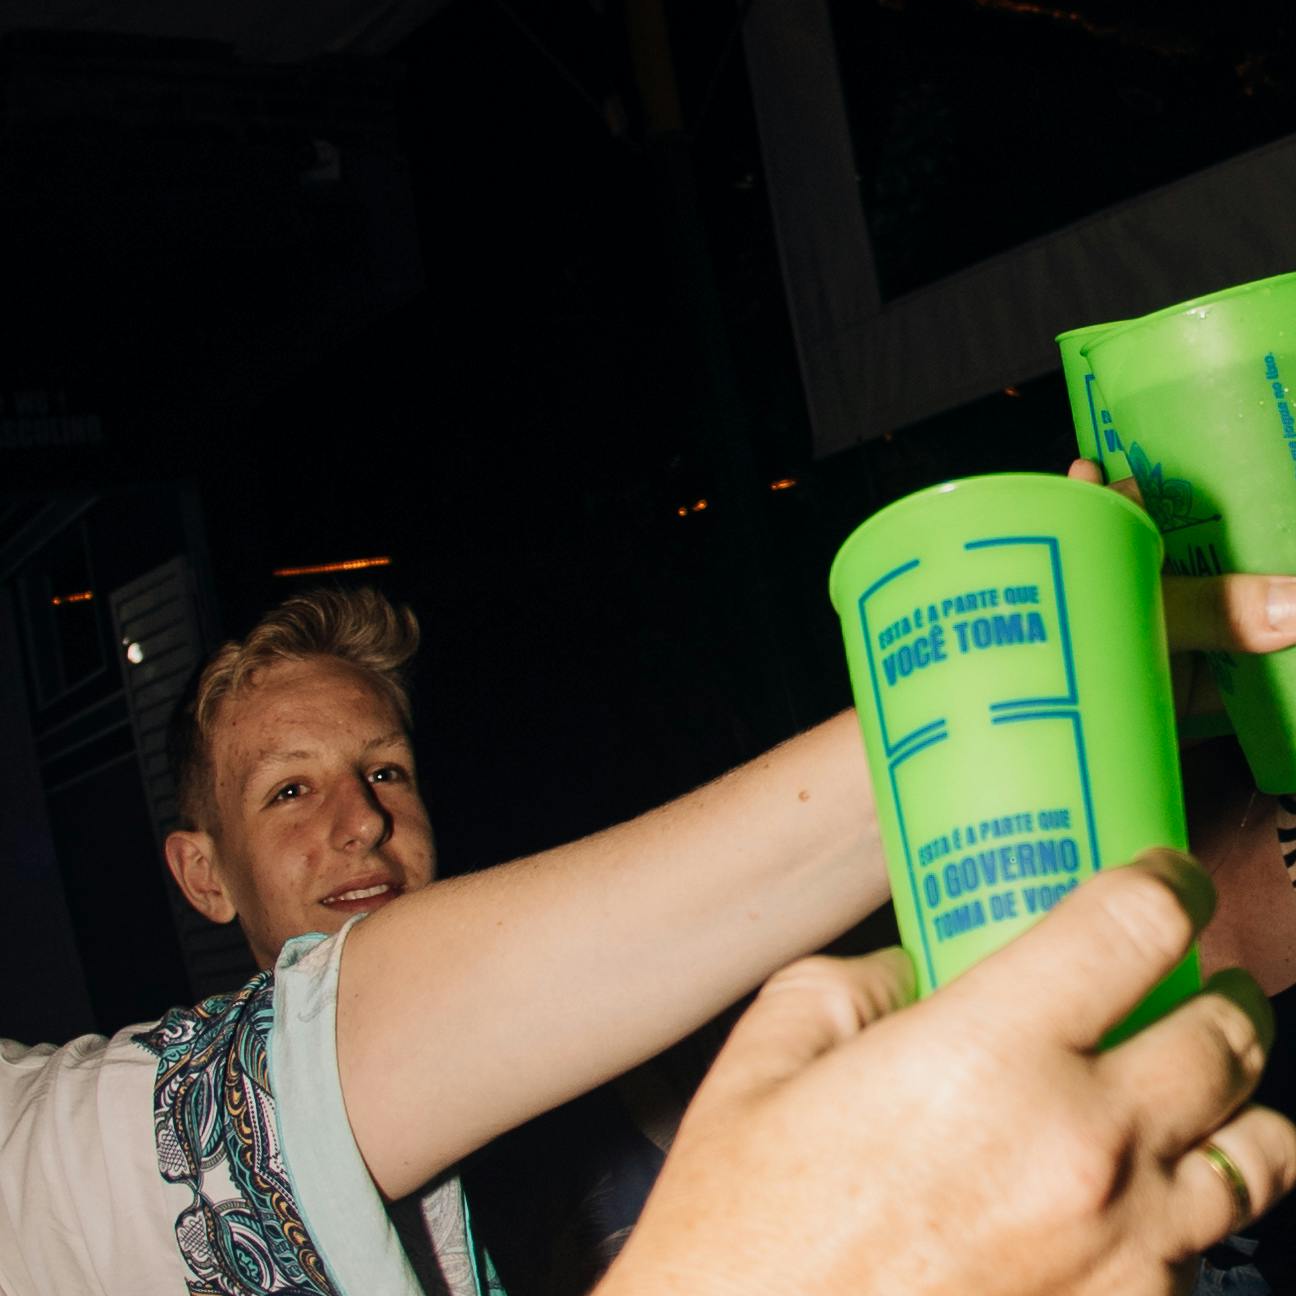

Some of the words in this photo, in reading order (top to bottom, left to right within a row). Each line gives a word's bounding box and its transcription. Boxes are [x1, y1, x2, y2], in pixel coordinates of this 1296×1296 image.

[878, 617, 912, 650] ESTA
[913, 607, 923, 629] É
[928, 605, 939, 623] A
[942, 588, 999, 617] PARTE
[1003, 585, 1040, 605] QUE
[882, 624, 948, 686] VOCÊ
[952, 612, 1048, 653] TOMA
[918, 836, 950, 867] ESTA
[952, 827, 962, 850] É
[966, 825, 977, 845] A
[979, 813, 1033, 841] PARTE
[1037, 808, 1071, 830] QUE
[924, 873, 940, 909] O
[944, 838, 1080, 898] GOVERNO
[933, 900, 986, 943] TOMA
[989, 891, 1018, 921] DE
